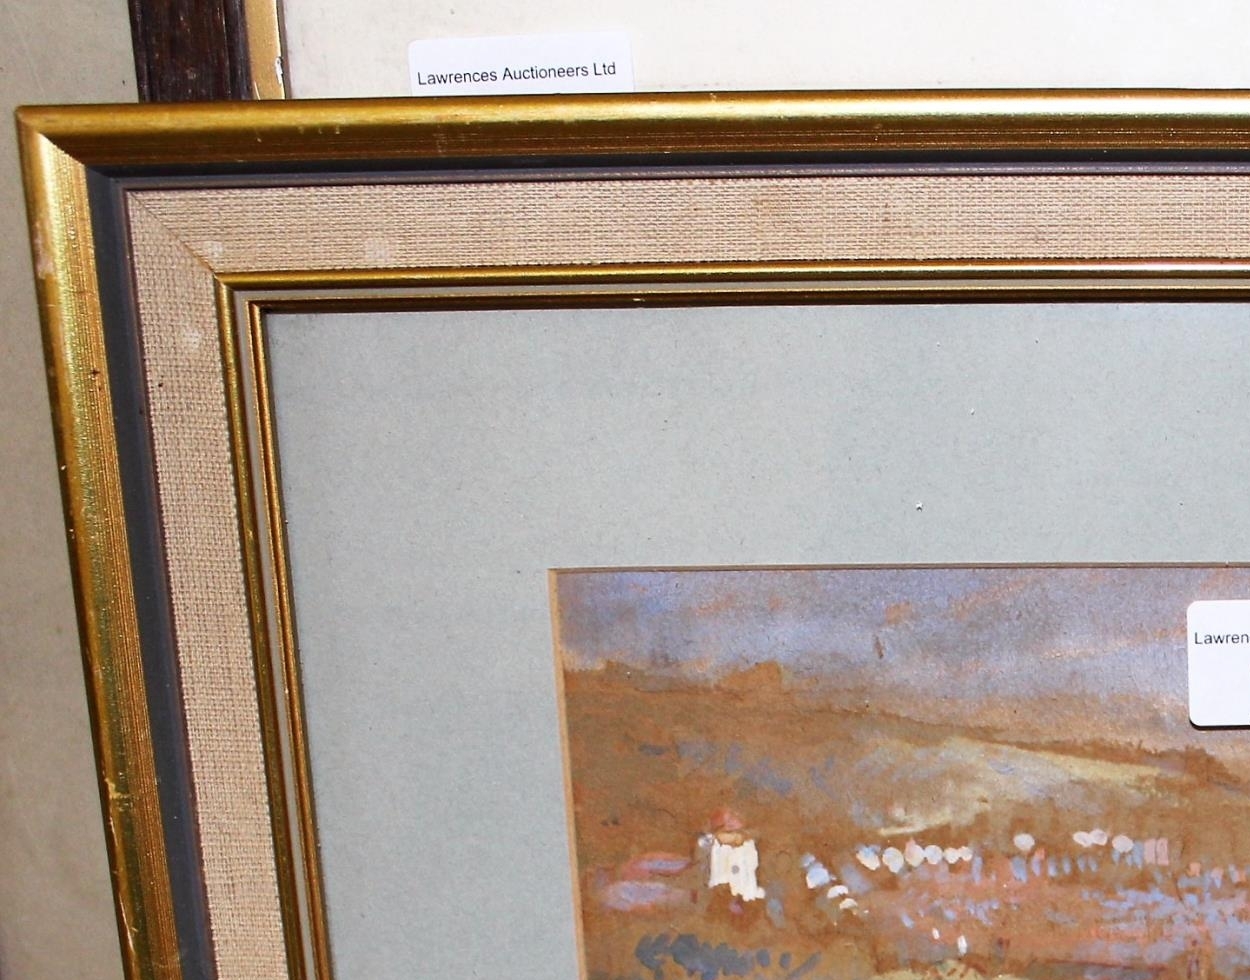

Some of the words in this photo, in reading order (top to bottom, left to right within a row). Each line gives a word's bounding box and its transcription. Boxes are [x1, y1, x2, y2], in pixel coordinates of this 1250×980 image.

[417, 70, 498, 86] Lawrences
[502, 63, 589, 81] Auctioneers
[593, 61, 617, 76] Ltd
